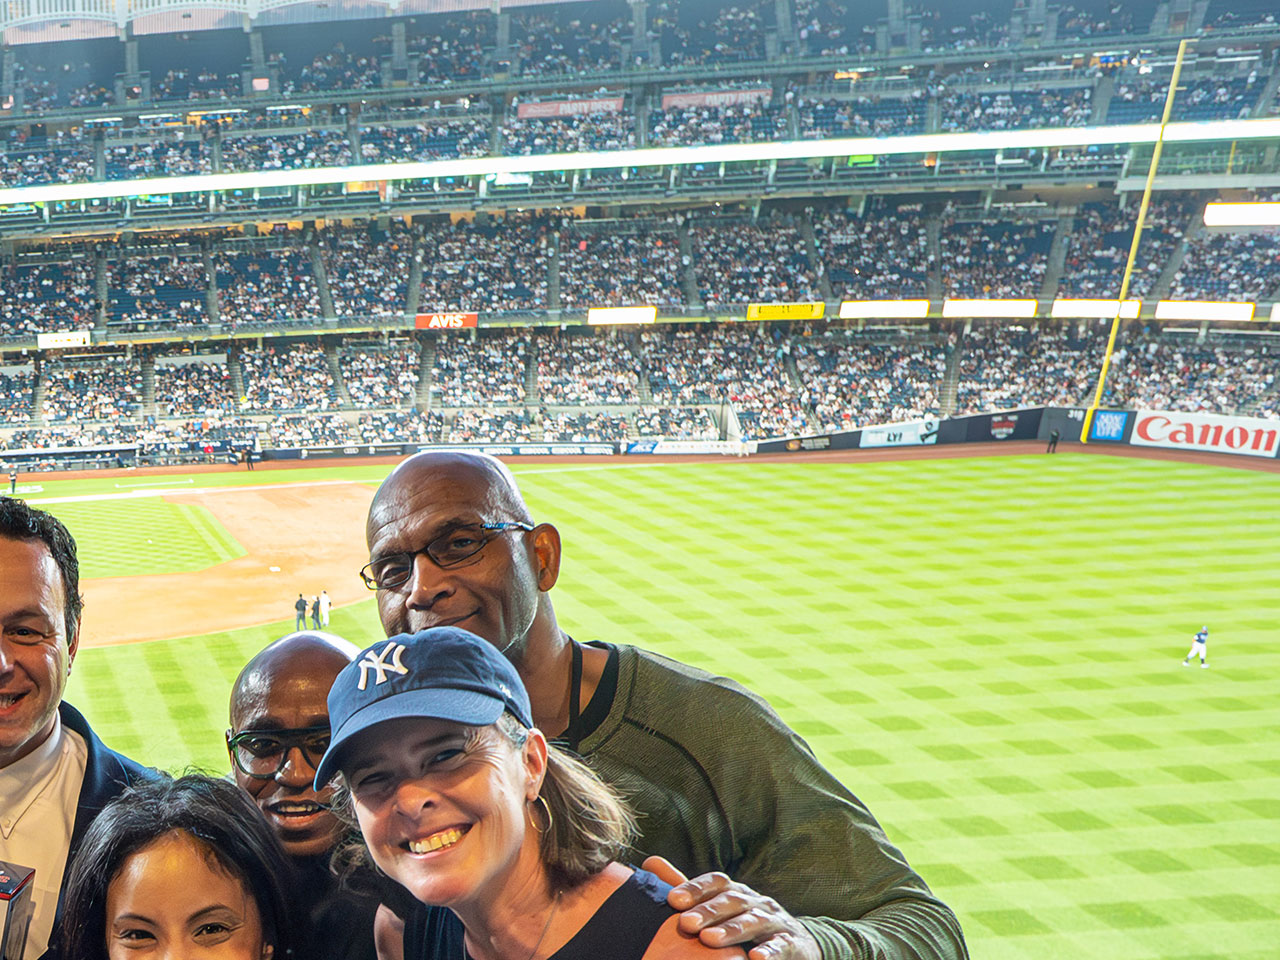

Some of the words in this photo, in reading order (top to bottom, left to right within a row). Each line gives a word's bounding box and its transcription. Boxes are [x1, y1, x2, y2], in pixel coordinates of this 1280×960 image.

[428, 314, 464, 328] AVIS
[1136, 415, 1277, 452] Canon
[357, 642, 409, 691] NY
